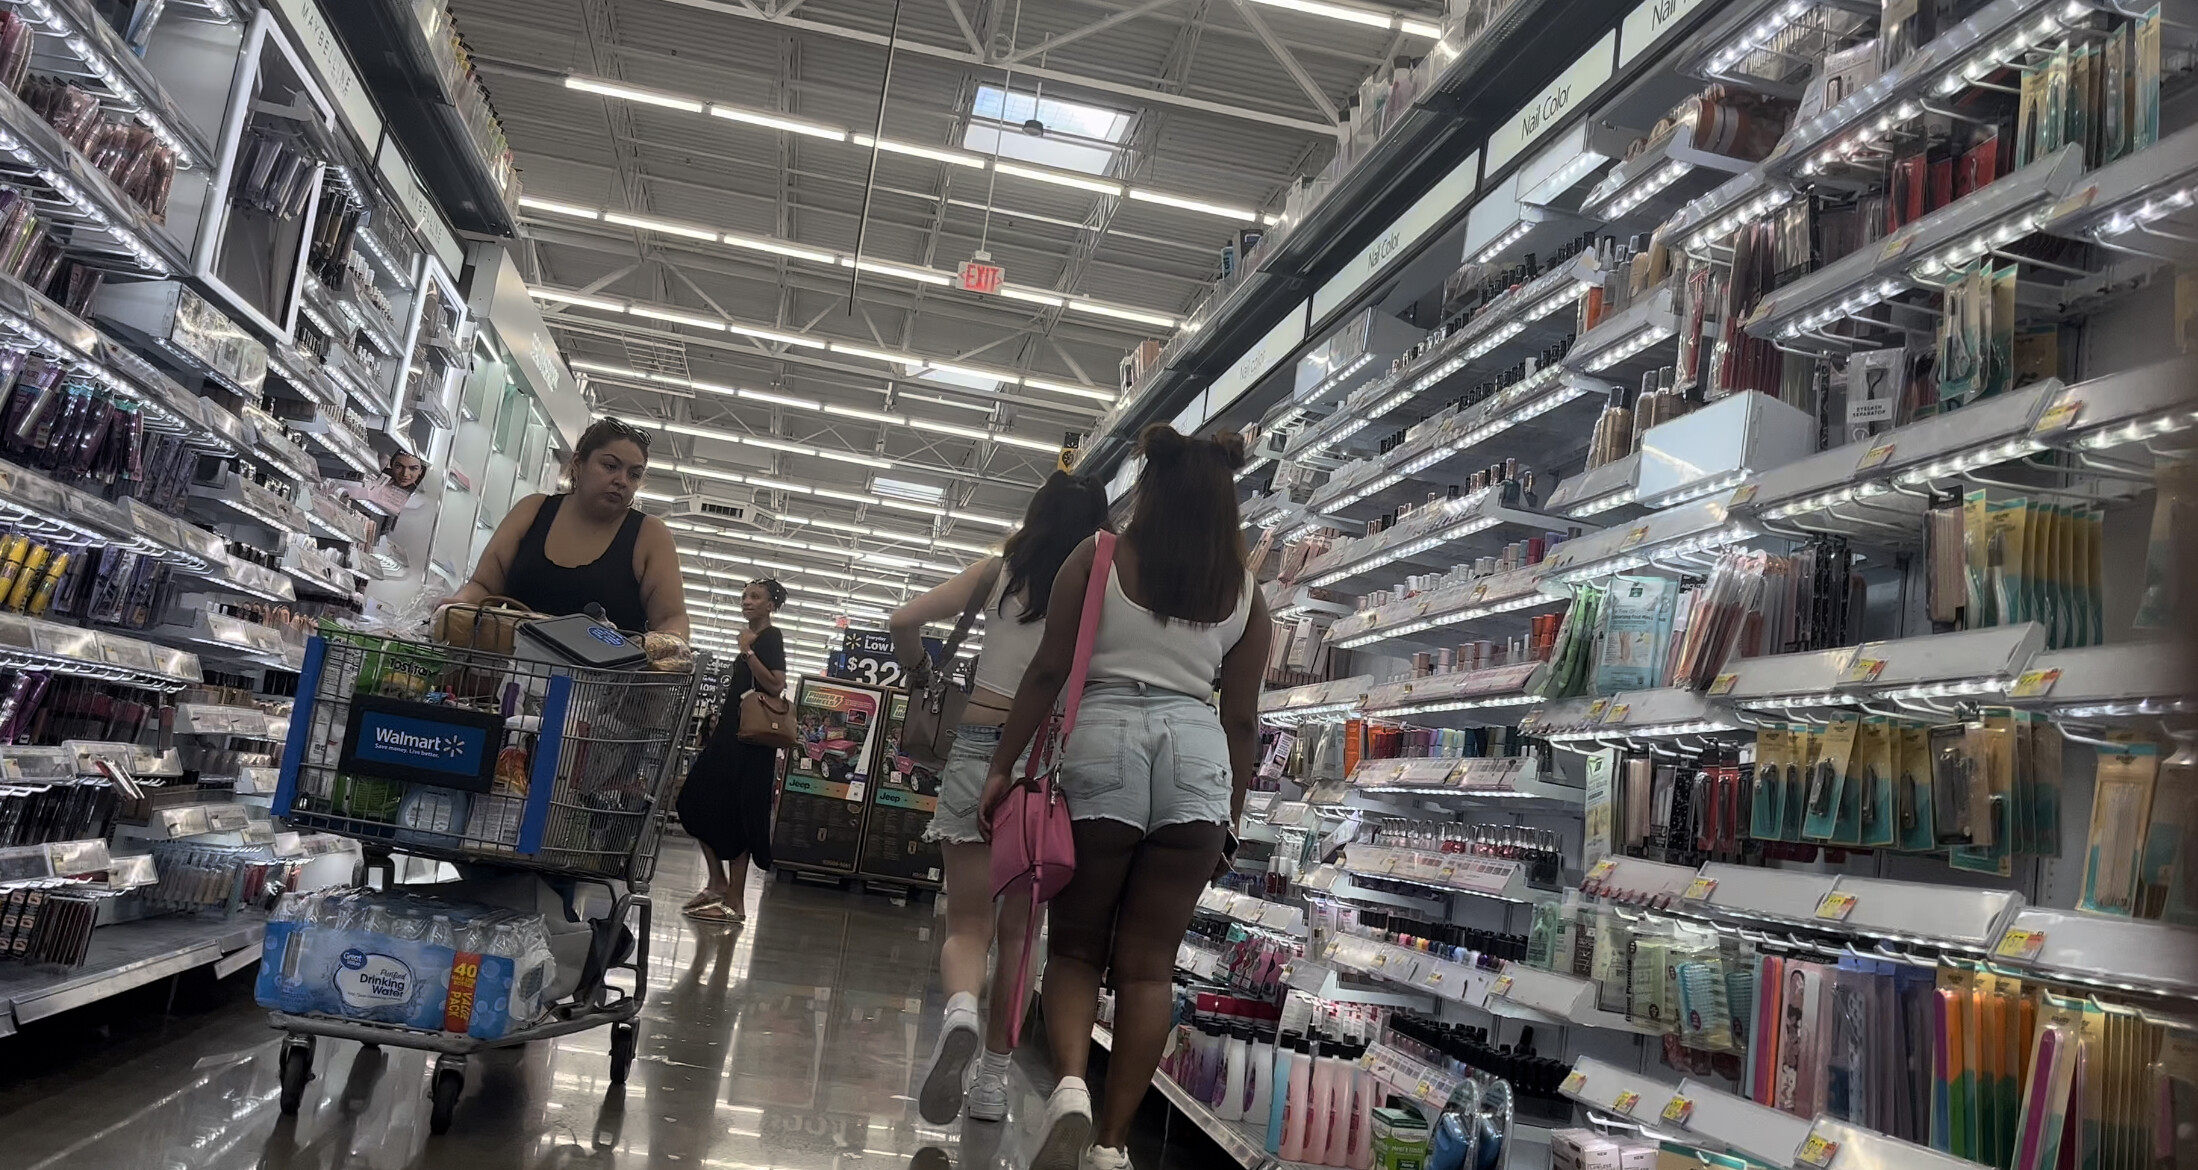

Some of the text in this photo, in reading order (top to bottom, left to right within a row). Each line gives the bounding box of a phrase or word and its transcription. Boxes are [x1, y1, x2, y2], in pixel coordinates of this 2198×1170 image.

[302, 2, 351, 92] MAYBELLINE
[1521, 84, 1571, 141] Nail Color
[1367, 231, 1400, 271] Nail Color
[965, 264, 999, 293] EXIT
[864, 640, 889, 652] Low
[376, 727, 441, 751] Walmart
[388, 746, 408, 754] money.
[421, 750, 440, 758] better.
[789, 778, 811, 790] Jeep
[879, 792, 900, 803] Jeep
[343, 952, 362, 962] Great
[380, 968, 407, 980] Purified
[453, 962, 477, 978] 40
[360, 973, 405, 991] Drinking
[372, 985, 404, 997] Water
[448, 991, 461, 1018] PACK
[460, 992, 473, 1020] VALUE
